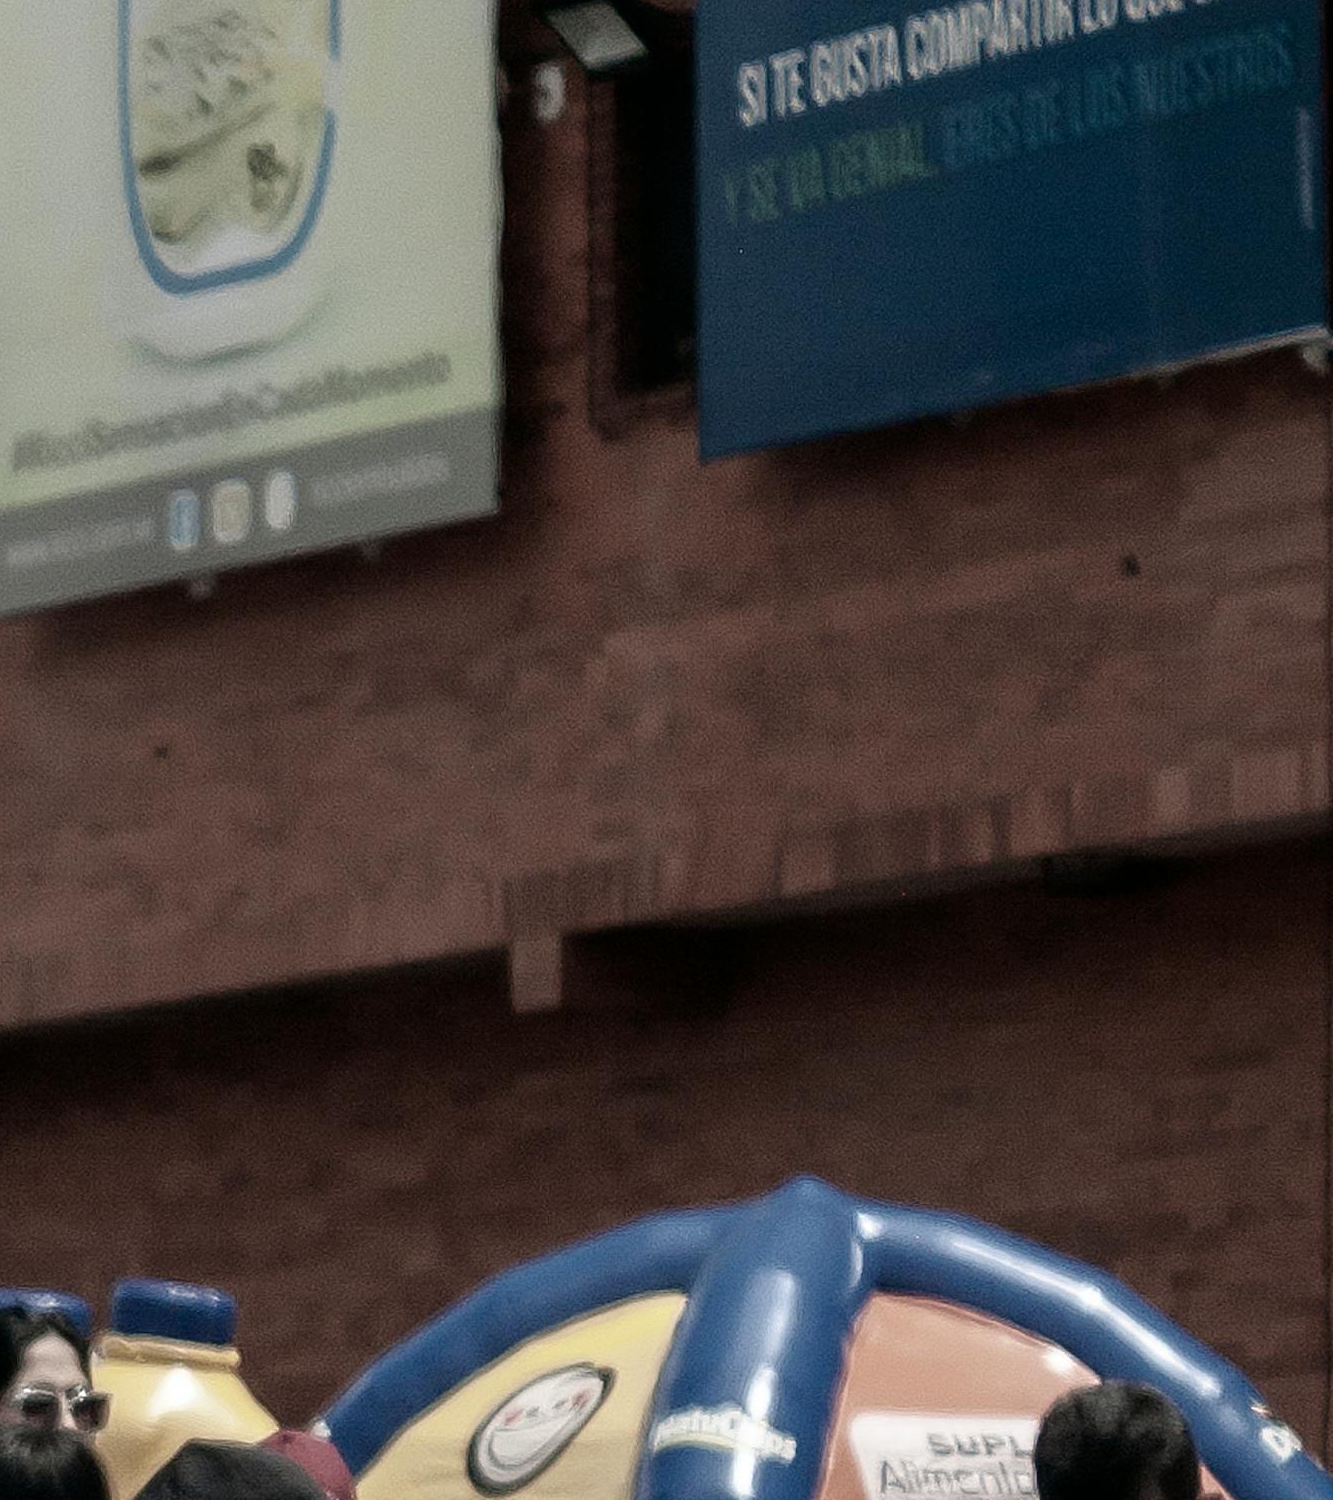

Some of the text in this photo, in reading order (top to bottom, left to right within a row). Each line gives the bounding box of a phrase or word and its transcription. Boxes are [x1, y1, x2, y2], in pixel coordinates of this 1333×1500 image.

[738, 61, 767, 127] SI
[772, 49, 807, 123] TE
[811, 25, 901, 109] GUSTA
